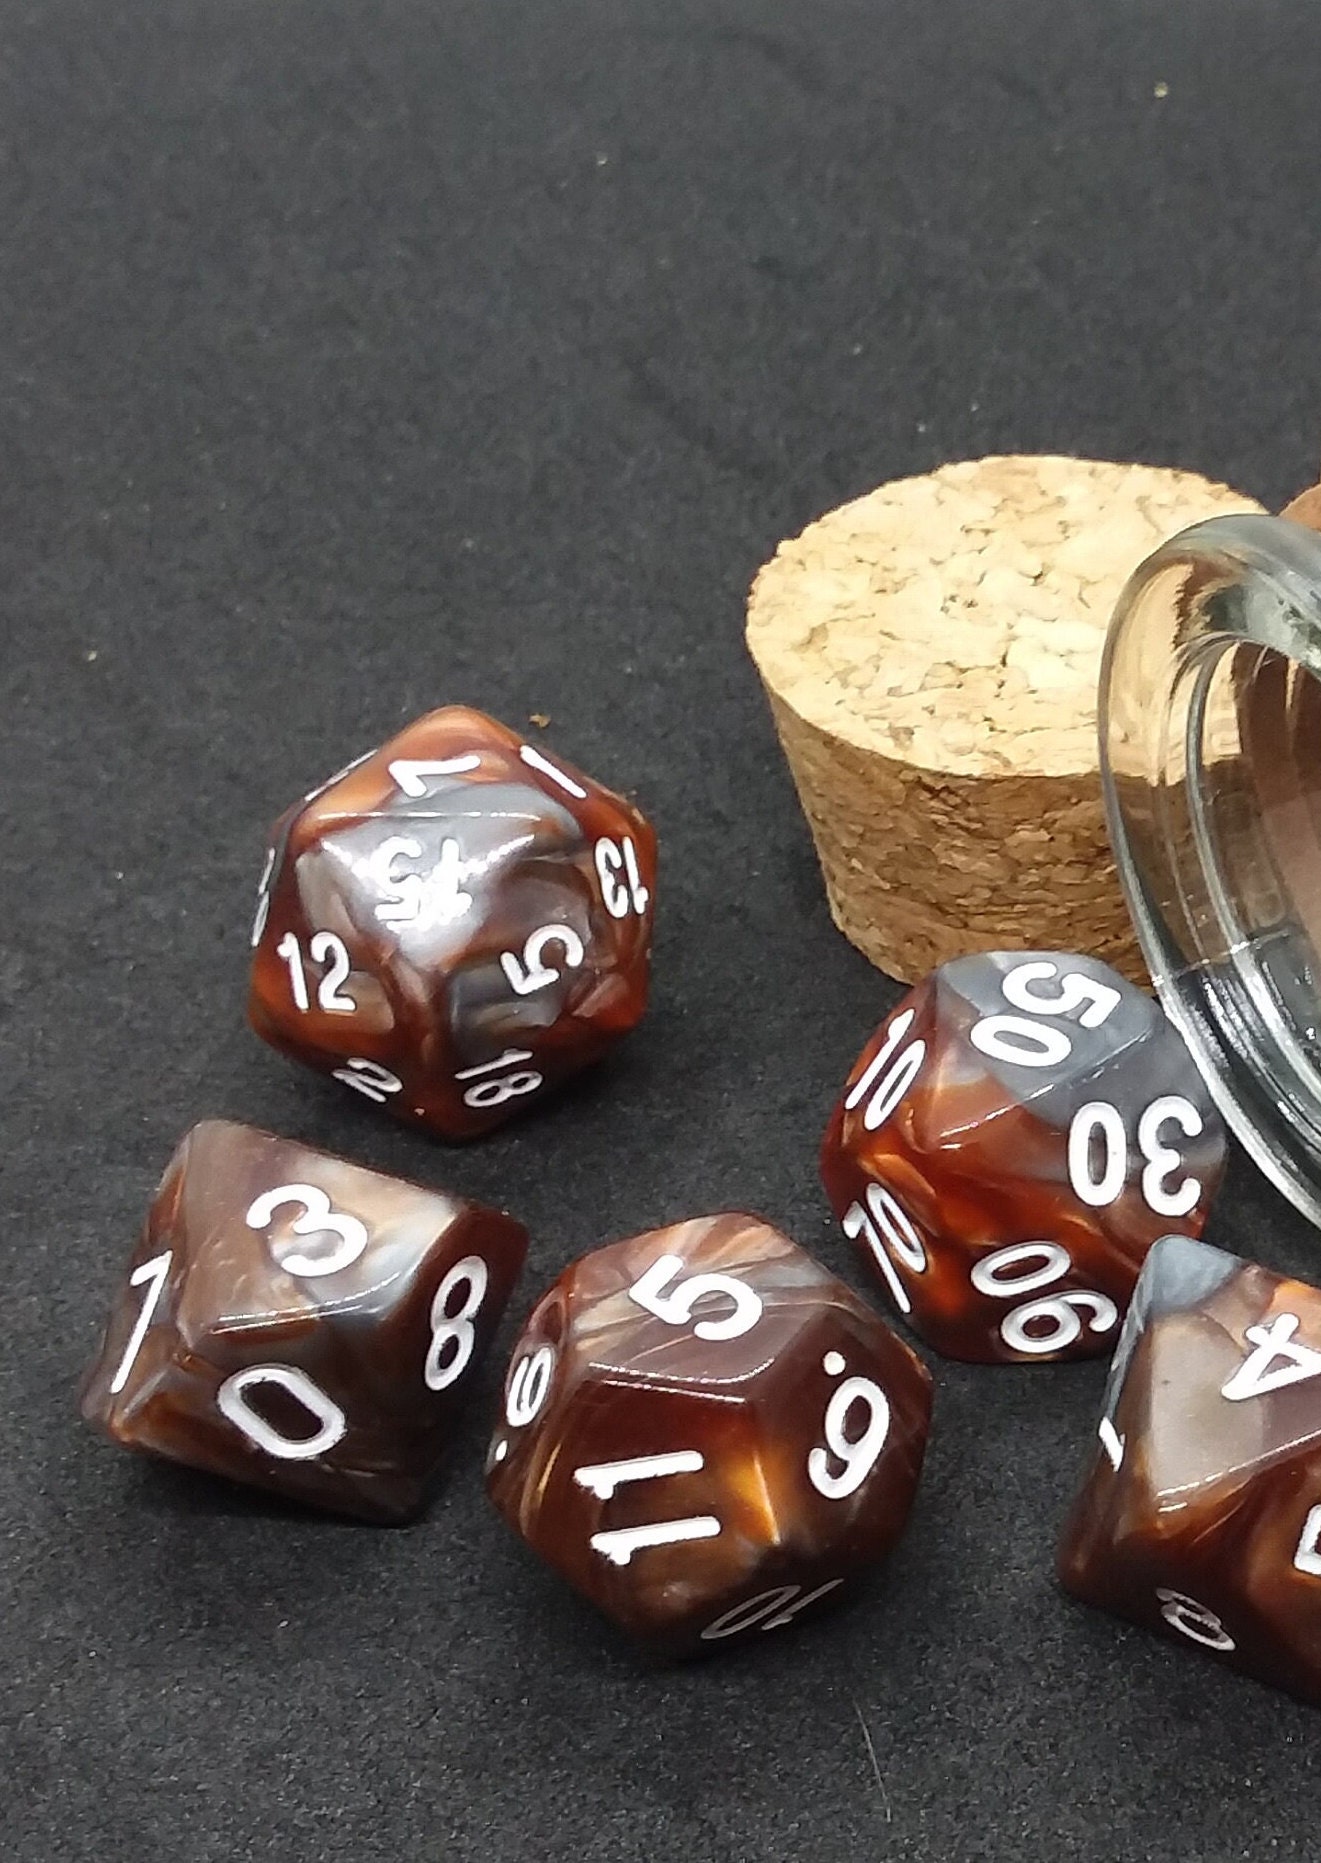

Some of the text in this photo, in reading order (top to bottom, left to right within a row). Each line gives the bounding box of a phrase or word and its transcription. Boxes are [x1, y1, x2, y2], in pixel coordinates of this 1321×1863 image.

[388, 755, 481, 798] 7
[595, 836, 649, 918] 13
[277, 932, 356, 1013] 12
[500, 924, 584, 995] 5
[970, 961, 1122, 1068] 50
[455, 1048, 544, 1108] 18
[845, 1008, 926, 1131] 10
[1068, 1096, 1203, 1217] 30
[246, 1183, 368, 1278] 3
[842, 1182, 927, 1314] 70
[425, 1255, 488, 1391] 8
[629, 1253, 763, 1341] 5
[970, 1240, 1118, 1354] 90
[217, 1362, 348, 1460] 0
[573, 1450, 721, 1566] 11
[700, 1578, 845, 1640] 10
